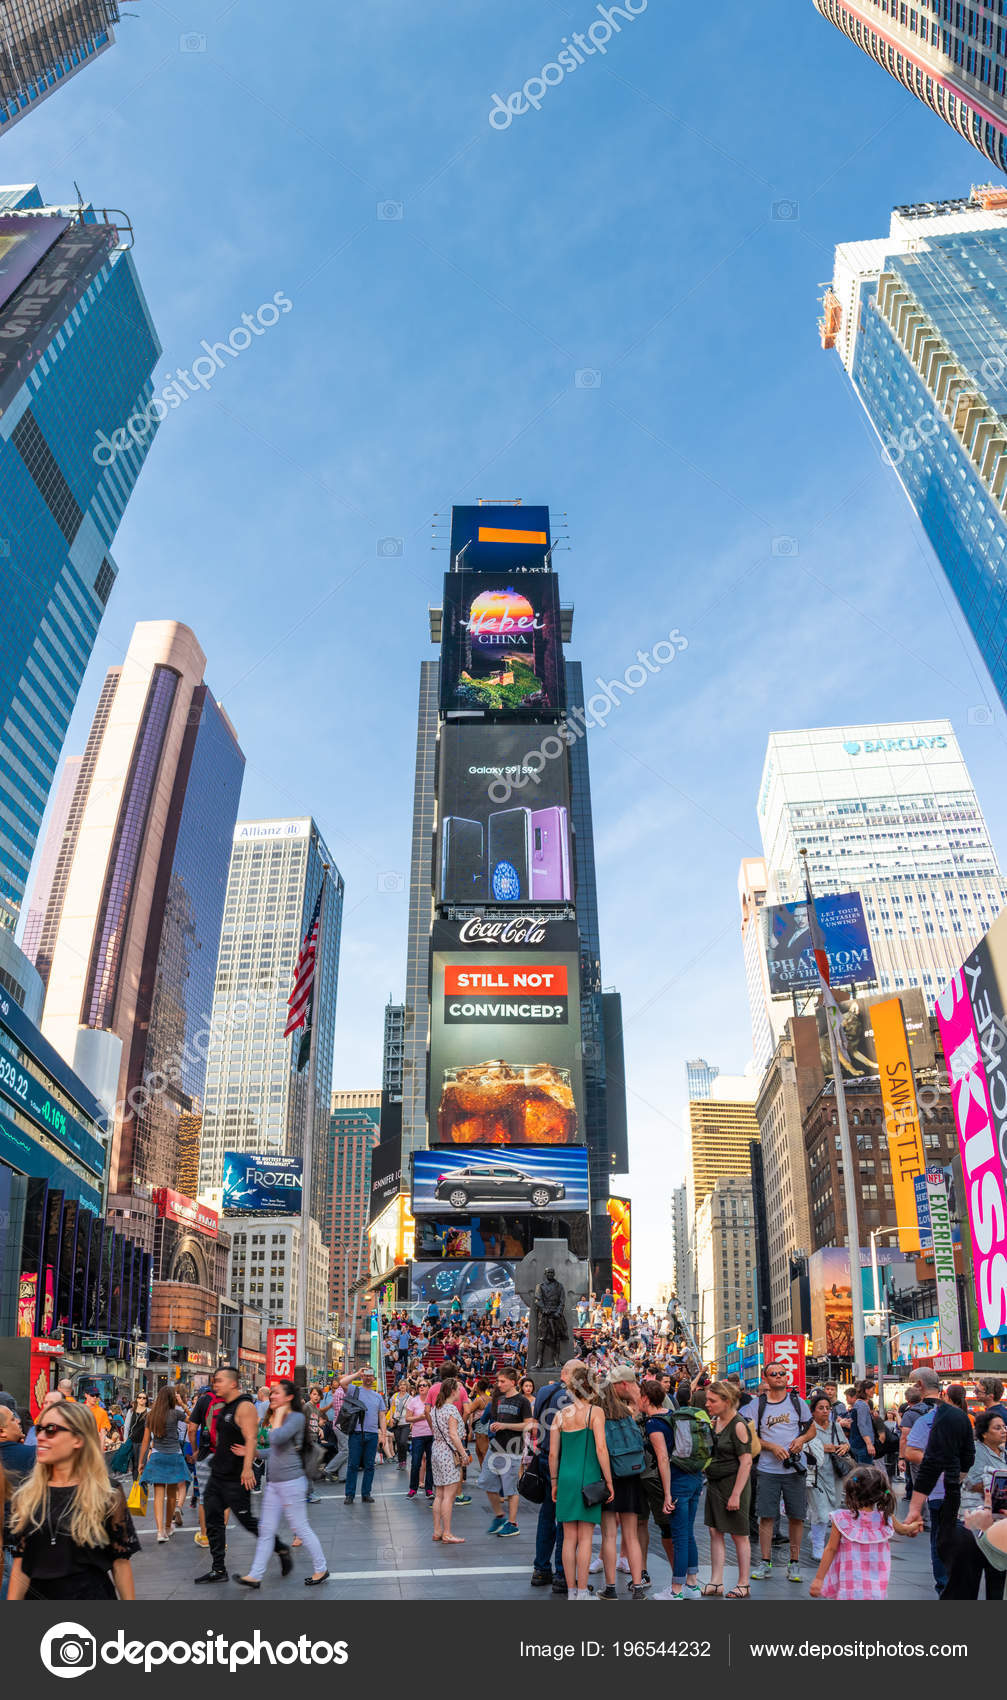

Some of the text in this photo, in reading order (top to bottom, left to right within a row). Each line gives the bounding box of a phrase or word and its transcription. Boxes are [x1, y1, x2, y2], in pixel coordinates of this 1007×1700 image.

[459, 605, 546, 636] Hebei
[478, 634, 528, 644] CHINA
[864, 736, 947, 753] BARCLAYS
[468, 766, 504, 776] Galaxy
[505, 766, 517, 774] S9
[240, 827, 282, 837] Allianz
[820, 913, 861, 923] FANTASIES
[826, 919, 857, 927] UNWIND
[457, 973, 554, 987] STILL NOT
[780, 971, 795, 981] OF
[829, 962, 862, 974] PERA
[449, 1004, 563, 1018] CONVINCED?
[42, 1101, 66, 1135] +0.16%
[887, 1061, 921, 1182] SAWEETIE
[246, 1168, 303, 1188] FROZEN
[372, 1173, 395, 1192] JENNIFER
[928, 1173, 944, 1183] NFL
[929, 1194, 956, 1283] EXPERIENCE
[275, 1333, 296, 1376] tkts
